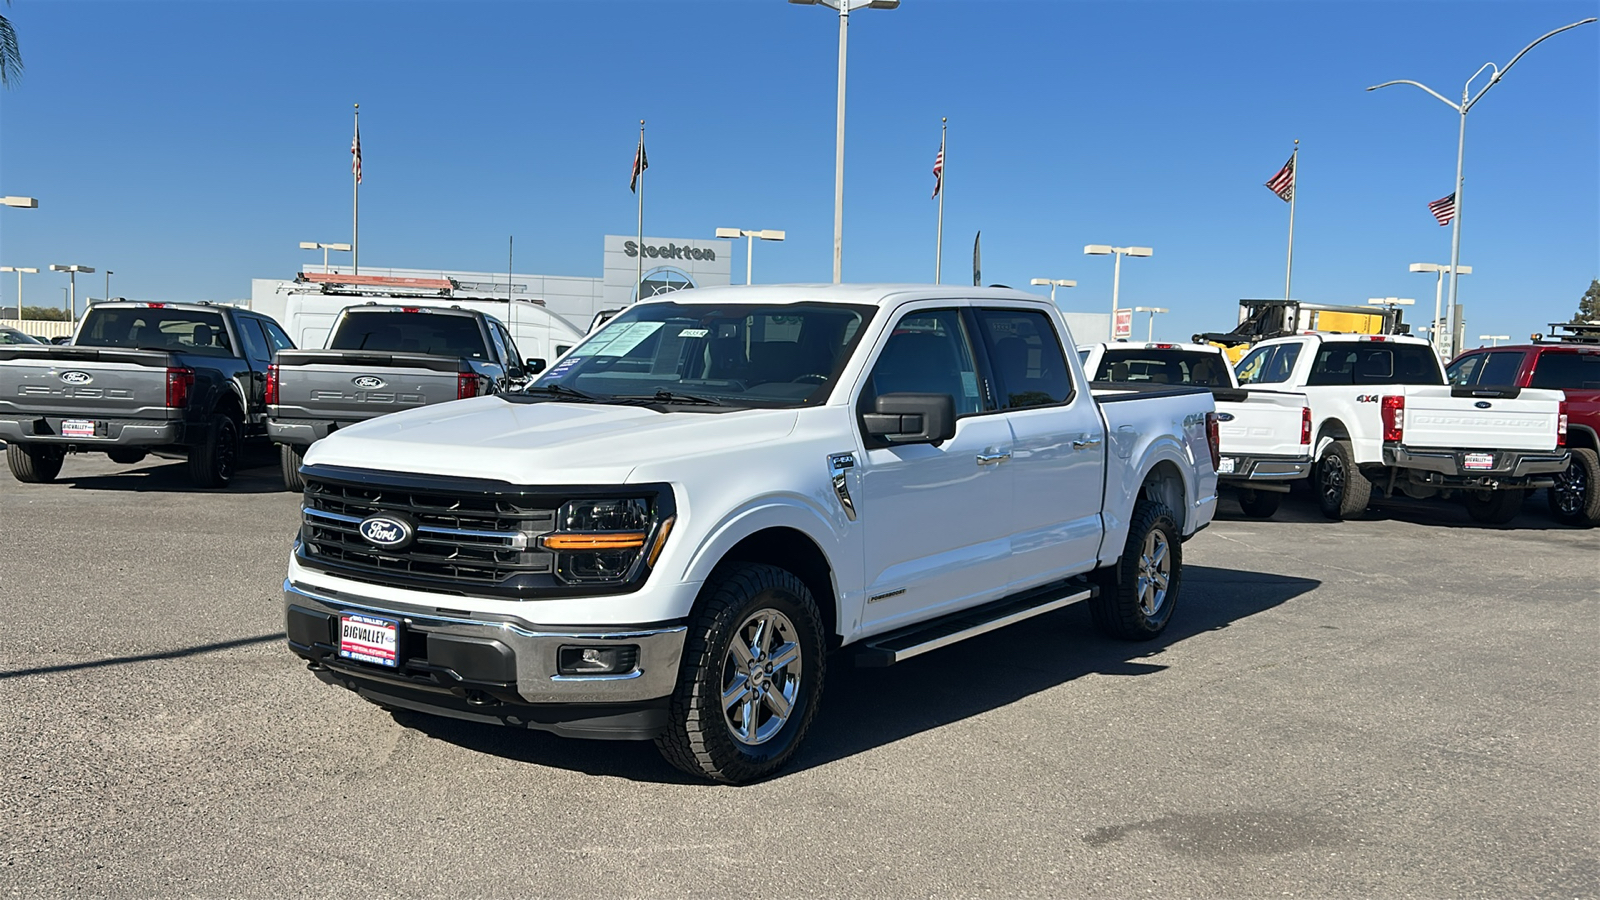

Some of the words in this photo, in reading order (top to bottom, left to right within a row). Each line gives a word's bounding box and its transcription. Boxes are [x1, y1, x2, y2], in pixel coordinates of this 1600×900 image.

[624, 240, 716, 261] Stockton
[18, 385, 134, 400] F-150
[310, 389, 426, 404] F-150
[367, 520, 397, 542] Ford
[343, 625, 386, 645] BIGVALLEY
